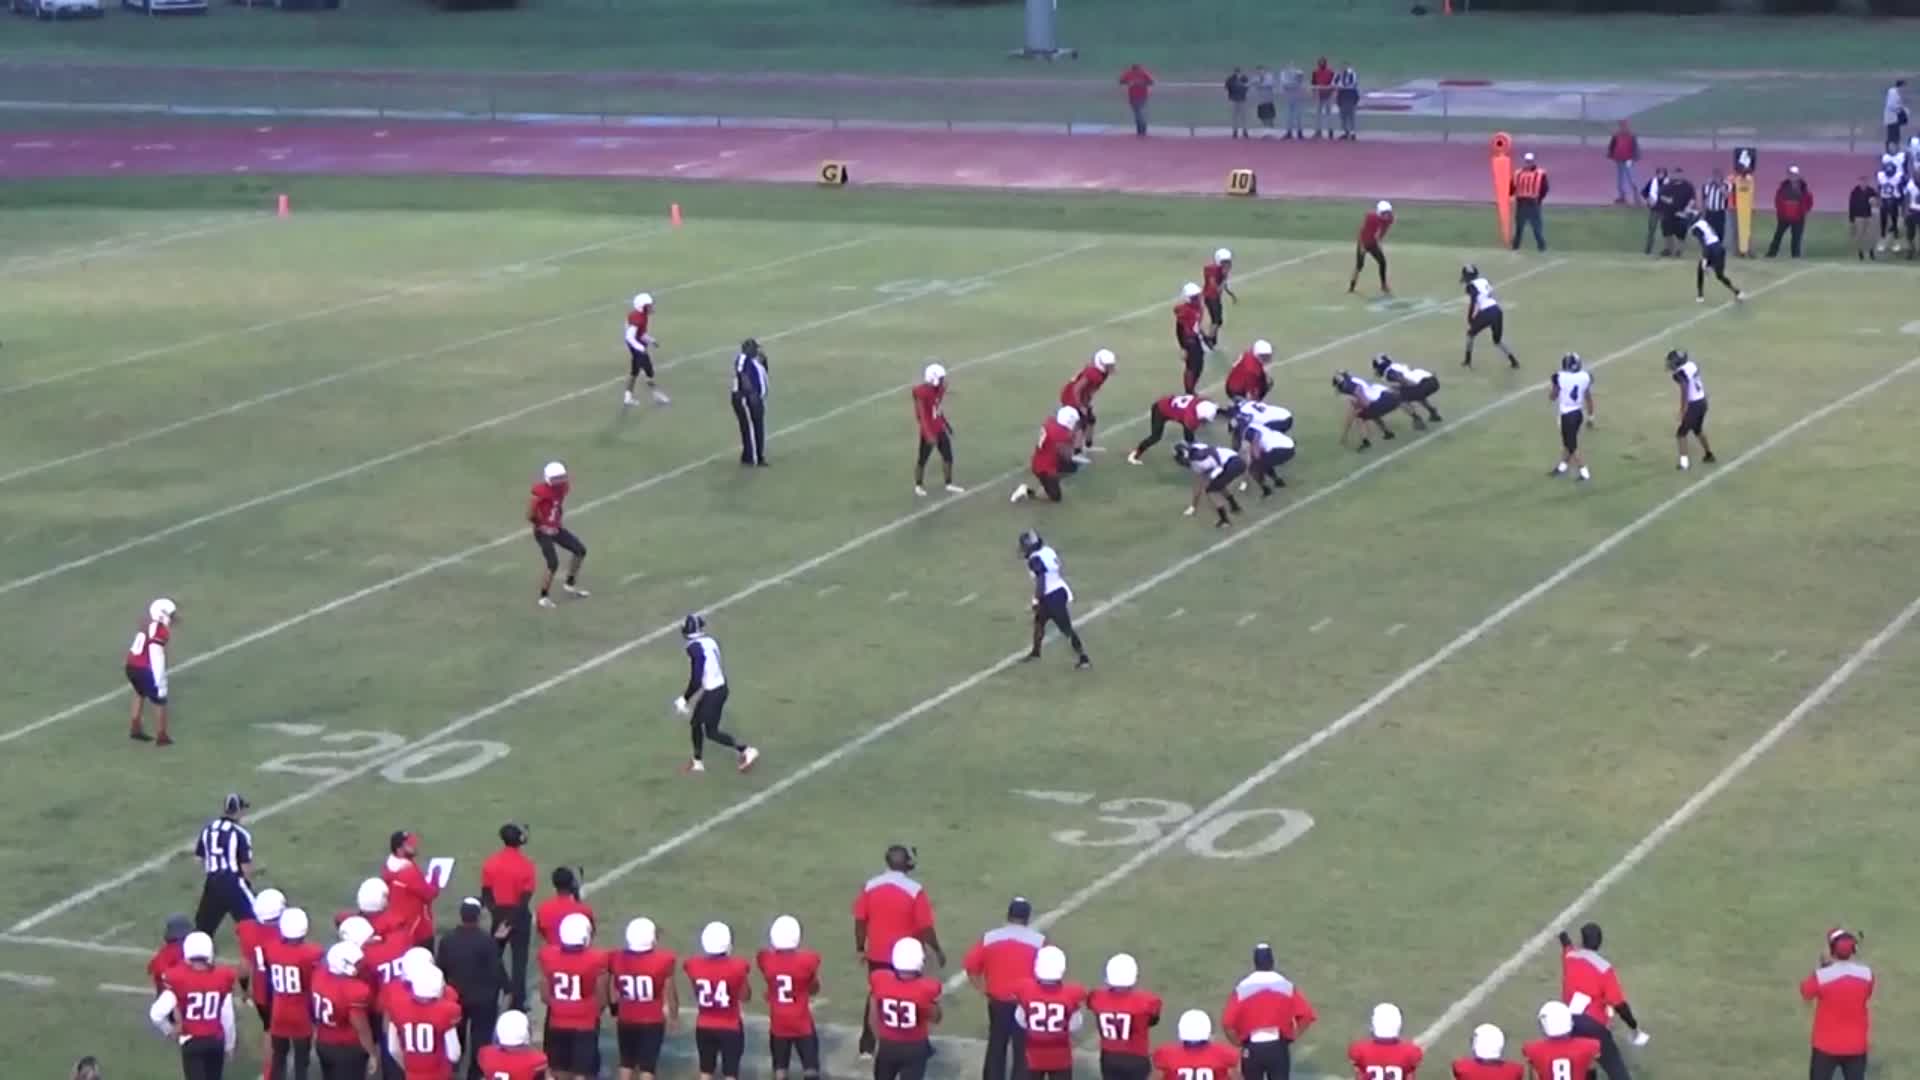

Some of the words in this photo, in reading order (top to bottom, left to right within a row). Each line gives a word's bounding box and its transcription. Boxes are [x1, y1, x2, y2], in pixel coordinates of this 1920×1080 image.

[822, 164, 839, 181] G
[1231, 172, 1249, 189] 10
[1570, 385, 1579, 401] 4
[1051, 797, 1315, 858] 30
[271, 963, 301, 993] 88
[553, 972, 582, 1001] 21
[618, 974, 654, 1002] 30
[776, 974, 793, 1003] 2
[186, 991, 219, 1020] 20
[696, 978, 730, 1008] 24
[883, 999, 917, 1029] 53
[1029, 1001, 1066, 1032] 22
[1100, 1012, 1132, 1041] 67
[403, 1022, 434, 1053] 10
